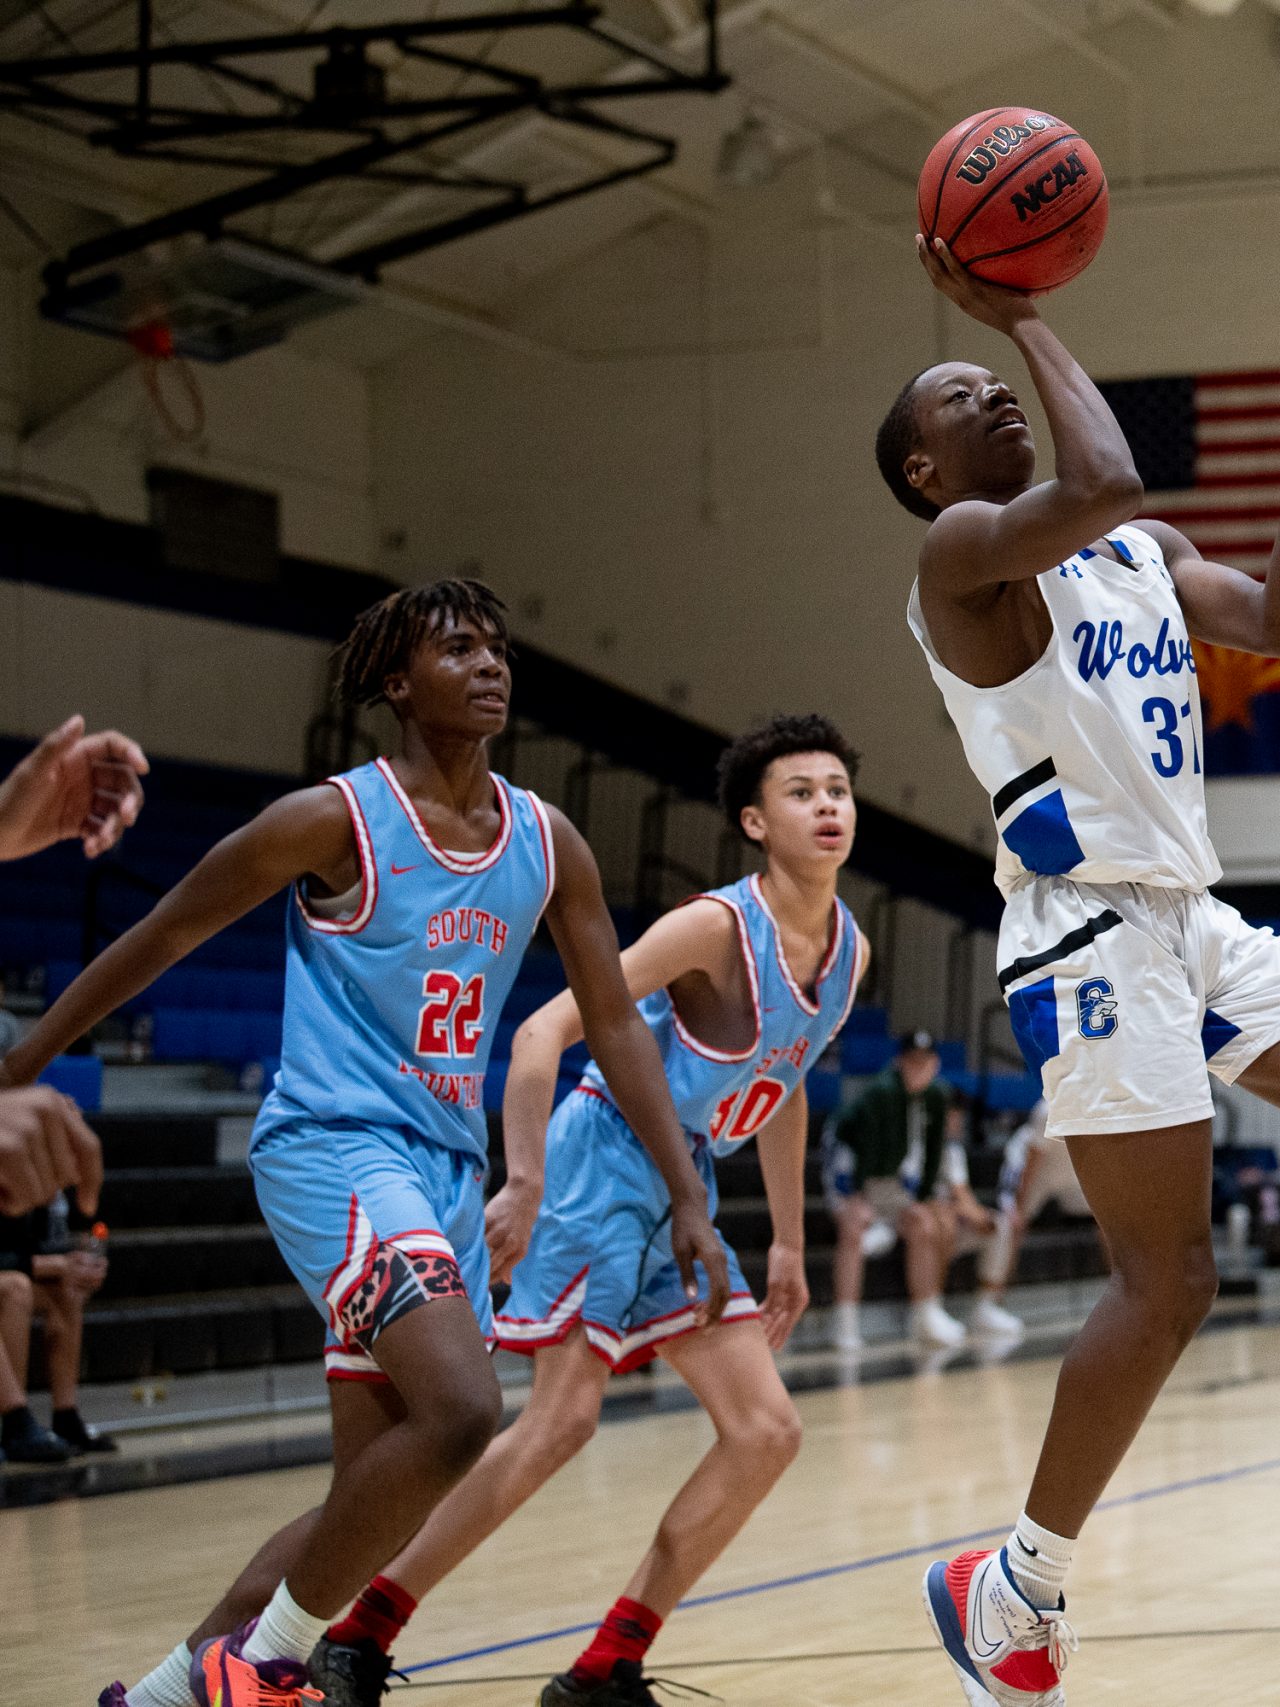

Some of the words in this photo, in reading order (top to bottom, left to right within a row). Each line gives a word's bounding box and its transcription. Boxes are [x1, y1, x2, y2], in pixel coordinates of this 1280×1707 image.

[1010, 150, 1089, 222] NCAA
[1072, 617, 1196, 683] Wolve
[426, 907, 508, 955] SOUTH
[415, 969, 486, 1058] 22
